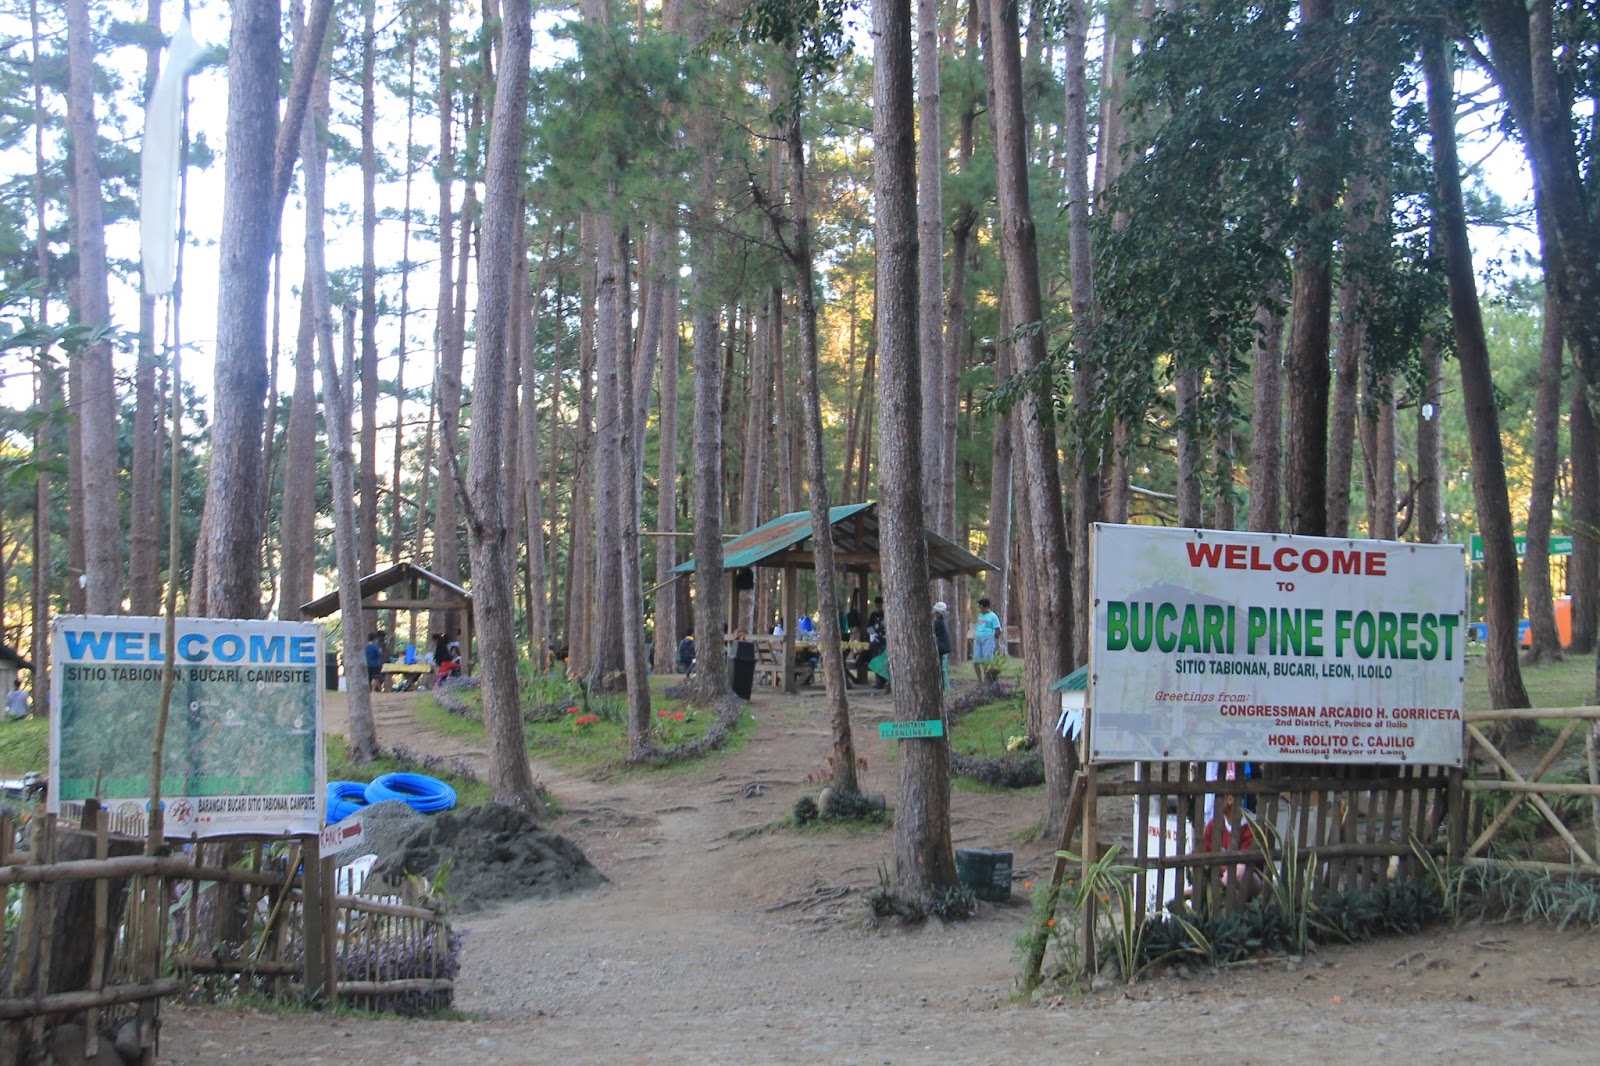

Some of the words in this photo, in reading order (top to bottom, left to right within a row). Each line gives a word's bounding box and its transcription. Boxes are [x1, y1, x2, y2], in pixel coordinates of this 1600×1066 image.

[1186, 542, 1387, 576] WELCOME
[1276, 582, 1295, 592] TO
[1107, 600, 1235, 656] BUCARI
[1249, 606, 1323, 657] PINE
[1335, 609, 1459, 661] FOREST
[64, 630, 316, 664] WELCOME
[68, 667, 106, 681] SITIO
[111, 668, 186, 684] TABIONN,
[190, 669, 243, 684] BUCARI,
[247, 670, 311, 683] CAMPSITE
[1175, 660, 1206, 674] SITIO
[1209, 661, 1270, 678] TABIONAN,
[1273, 664, 1319, 679] BUCARI,
[1322, 665, 1354, 679] LEON,
[1357, 666, 1392, 679] ILOILO
[1155, 691, 1214, 702] Greetings
[1217, 692, 1250, 702] from:
[1220, 705, 1315, 718] CONGRESSMAN
[1320, 707, 1373, 719] ARCADIO
[1377, 709, 1389, 719] H.
[1392, 708, 1460, 720] GORRICETA
[1275, 719, 1292, 727] 2nd
[1295, 719, 1331, 728] District,
[1334, 720, 1372, 728] Province
[1375, 720, 1384, 728] of
[881, 729, 933, 737] CLEANLINESS
[1268, 734, 1299, 746] HON.
[1303, 735, 1348, 747] ROLITO
[1352, 736, 1364, 747] C.
[1367, 736, 1415, 748] CAJILIG
[1280, 747, 1329, 755] Municipal
[1332, 748, 1363, 756] Mayor
[198, 799, 227, 813] BARANGAY
[227, 798, 247, 812] BUCARI
[248, 798, 261, 811] SITIO
[290, 797, 315, 810] CAMPSITE
